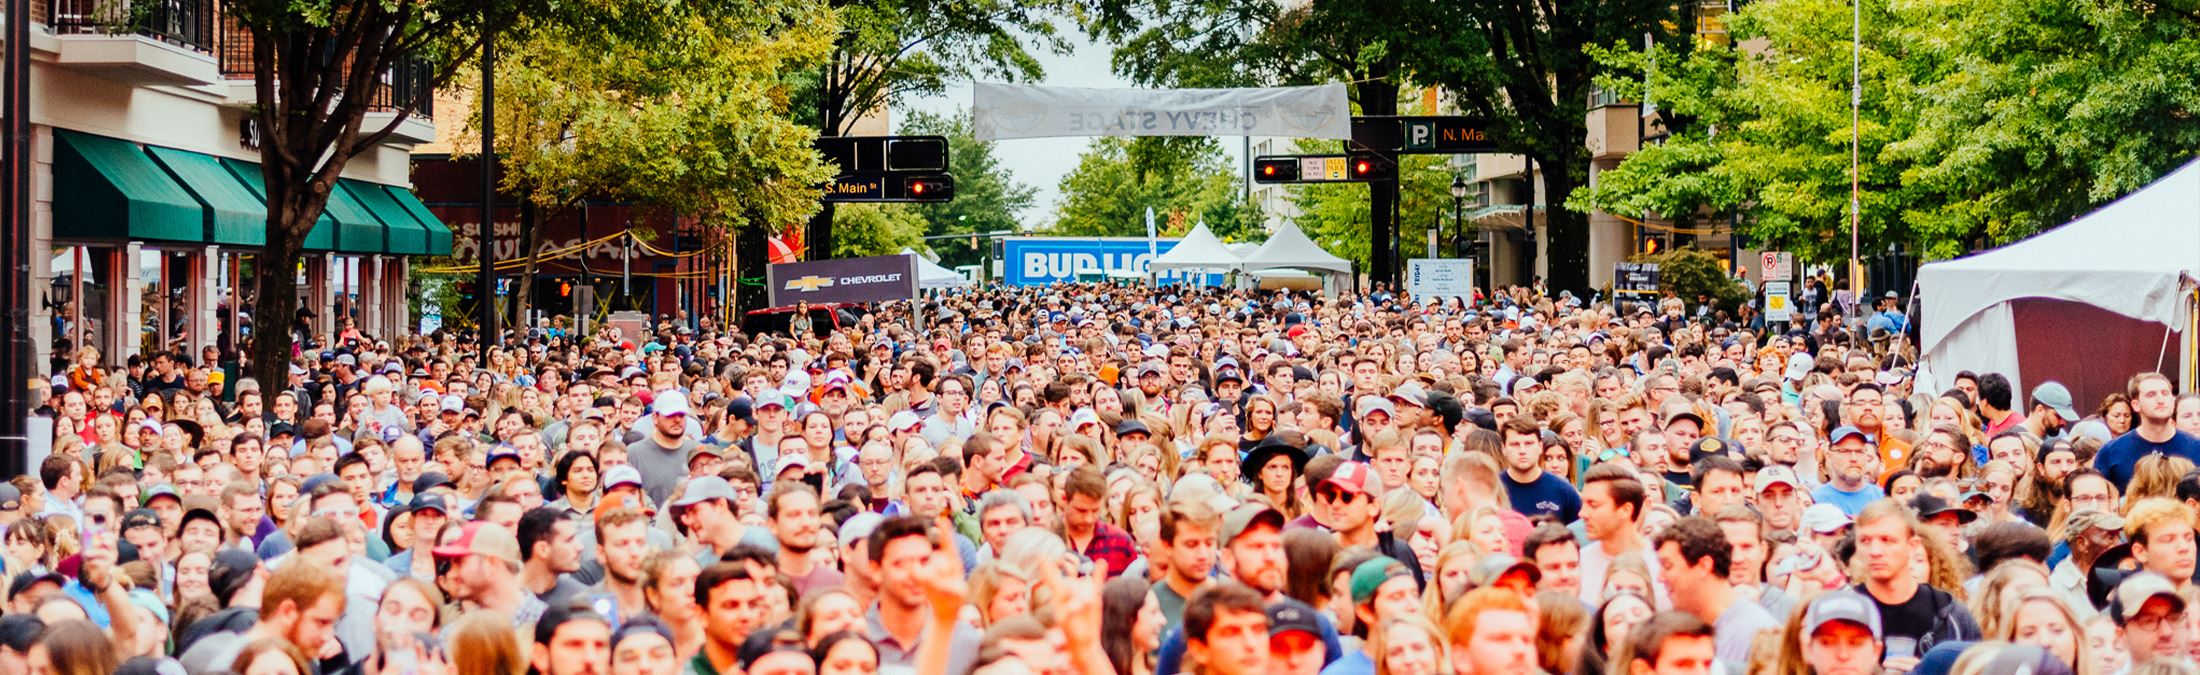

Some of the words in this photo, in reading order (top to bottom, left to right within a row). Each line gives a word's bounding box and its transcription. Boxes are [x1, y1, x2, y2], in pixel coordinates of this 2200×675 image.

[1443, 128, 1457, 141] N.
[825, 183, 836, 193] S.
[839, 183, 867, 193] Main
[1024, 253, 1098, 278] BUD
[840, 274, 901, 285] CHEVROLET
